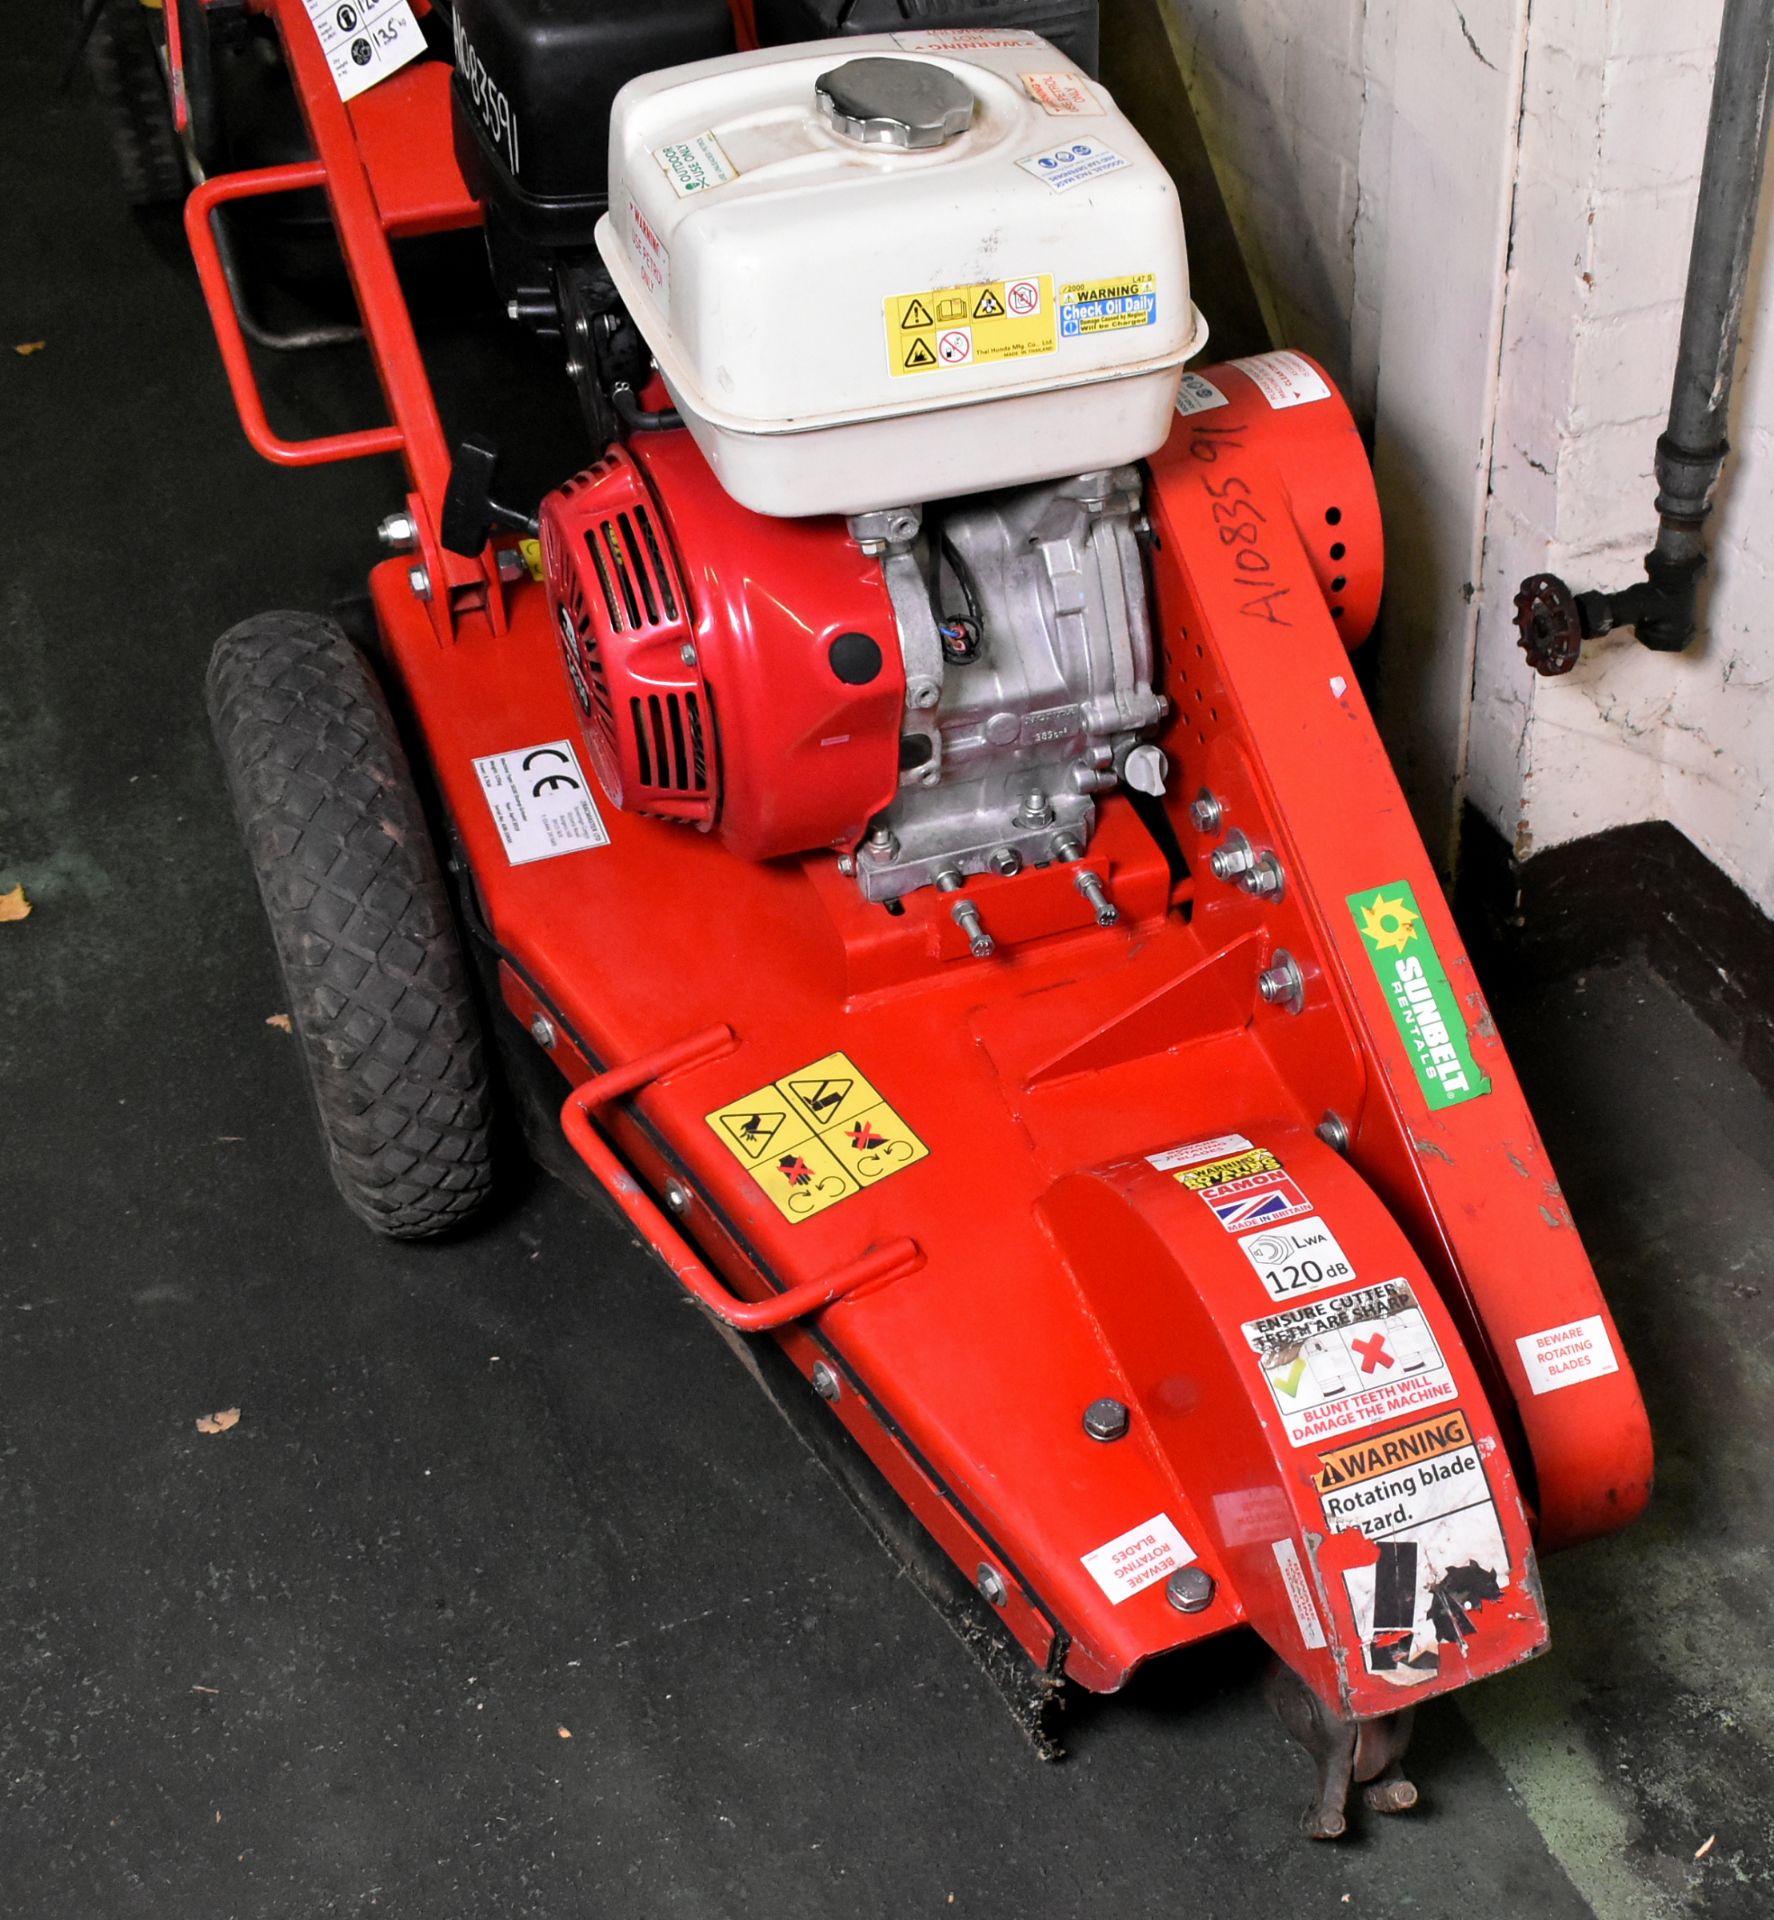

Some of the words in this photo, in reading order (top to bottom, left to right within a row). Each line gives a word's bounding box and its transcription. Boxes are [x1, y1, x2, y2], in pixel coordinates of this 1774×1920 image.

[928, 41, 1022, 51] WARNING
[663, 145, 692, 183] OUTDOOR
[675, 143, 695, 162] ONLY
[688, 161, 705, 177] USE
[1063, 302, 1102, 320] Check
[1106, 299, 1122, 315] Oil
[1125, 295, 1154, 312] Daily
[1077, 284, 1139, 302] WARNING
[1112, 318, 1147, 327] Charged
[1391, 981, 1438, 1080] RENTALS
[1394, 956, 1470, 1093] SUNBELT
[1167, 1141, 1228, 1160] ROTATING
[1177, 1147, 1225, 1161] BLADES
[1195, 1155, 1256, 1177] WARNING
[1202, 1171, 1288, 1199] CAMON
[1227, 1217, 1258, 1232] MADE
[1259, 1215, 1271, 1223] IN
[1272, 1203, 1313, 1220] BRITAIN
[1265, 1260, 1323, 1294] 120
[1326, 1262, 1349, 1279] dB
[1255, 1304, 1327, 1334] ENSURE
[1329, 1283, 1399, 1311] CUTTER
[1315, 1311, 1350, 1333] ARE
[1351, 1293, 1410, 1321] SHARP
[1536, 1326, 1584, 1348] BEWARE
[1537, 1339, 1593, 1364] ROTATING
[1548, 1355, 1592, 1376] BLADES
[1292, 1413, 1356, 1440] DAMAGE
[1358, 1405, 1385, 1421] THE
[1387, 1383, 1452, 1411] MACHINE
[1303, 1399, 1350, 1423] BLUNT
[1351, 1387, 1395, 1409] TEETH
[1396, 1375, 1433, 1393] WILL
[1340, 1420, 1466, 1478] WARNING
[1328, 1475, 1417, 1517] Rotating
[1418, 1454, 1476, 1486] blade
[1111, 1534, 1157, 1564] BLADES
[1113, 1543, 1171, 1579] ROTATING
[1128, 1556, 1176, 1588] BEWARE
